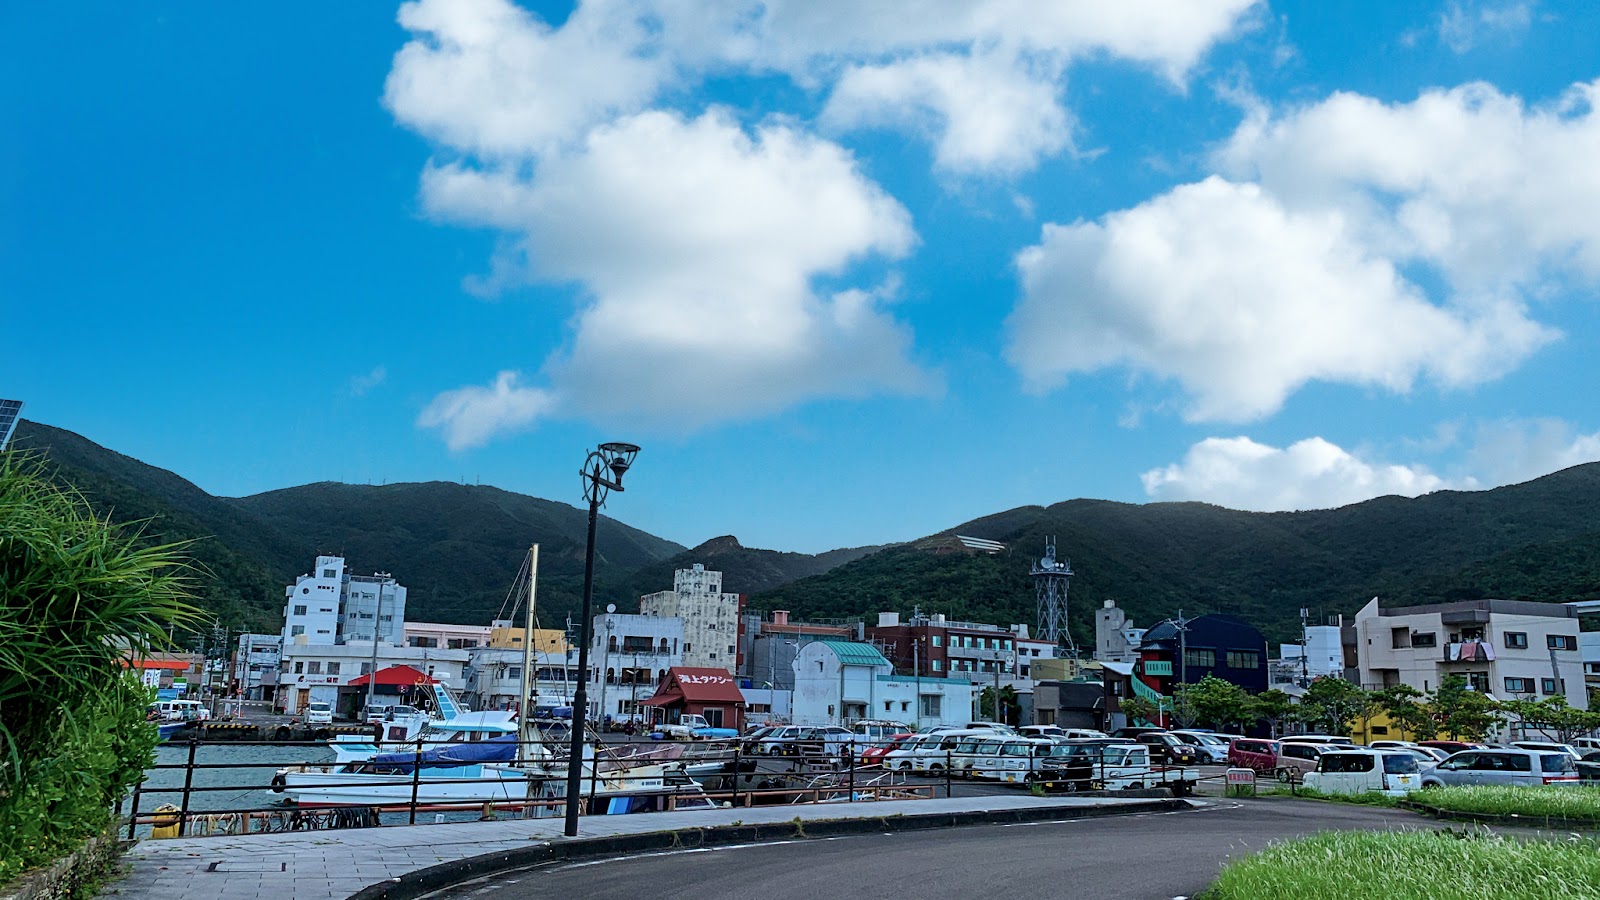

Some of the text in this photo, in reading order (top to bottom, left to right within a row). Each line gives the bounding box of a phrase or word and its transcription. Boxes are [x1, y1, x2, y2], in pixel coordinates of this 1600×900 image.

[678, 674, 733, 684] 海上タクシー
